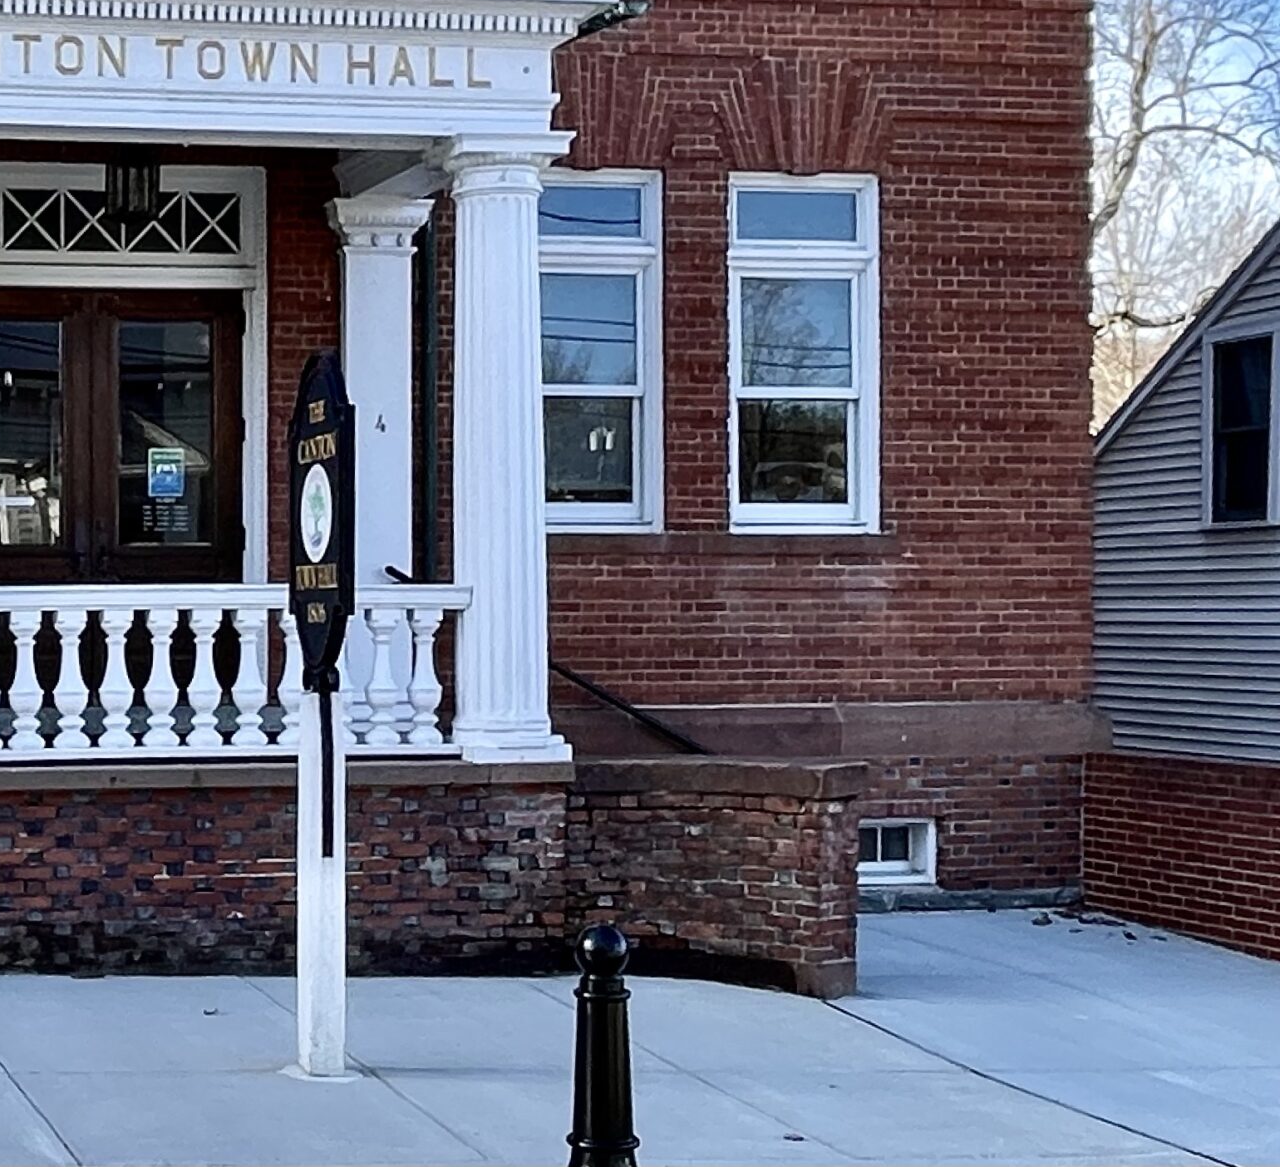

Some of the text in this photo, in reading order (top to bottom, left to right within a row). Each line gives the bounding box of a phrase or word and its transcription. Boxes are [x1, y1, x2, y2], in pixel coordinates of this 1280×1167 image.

[155, 38, 319, 83] TOWN
[346, 44, 493, 89] HALL
[297, 432, 337, 465] CANTON
